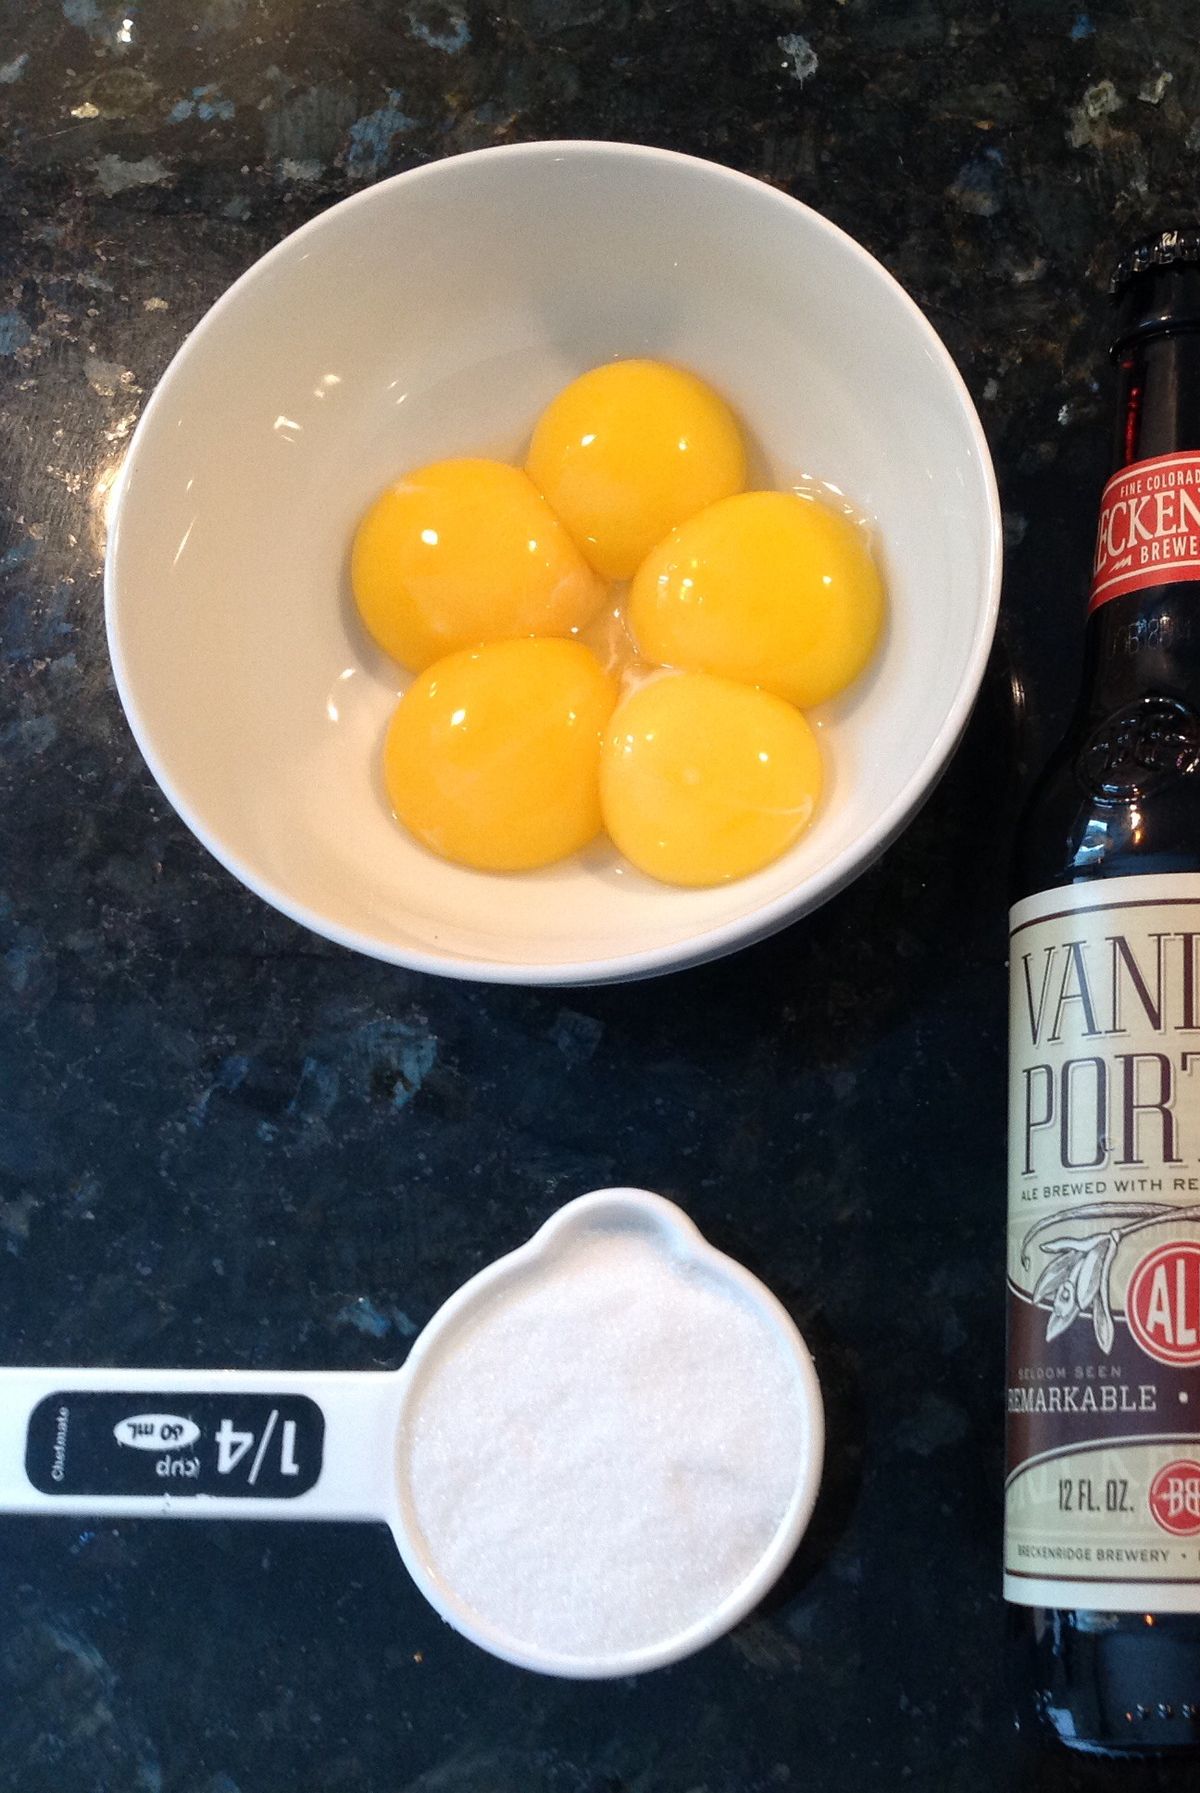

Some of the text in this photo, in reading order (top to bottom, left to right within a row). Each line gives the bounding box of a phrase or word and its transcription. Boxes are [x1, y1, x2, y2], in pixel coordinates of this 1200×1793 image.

[1120, 481, 1142, 497] FINE
[1021, 1190, 1038, 1201] ALE
[1043, 1181, 1107, 1198] BREWED
[1115, 1179, 1162, 1193] WITH
[1018, 1365, 1121, 1380] SELDOM SEEN
[214, 1409, 300, 1485] 1/4
[156, 1455, 198, 1478] cup
[1059, 1479, 1073, 1511] 12
[1078, 1479, 1101, 1512] FL.
[1106, 1479, 1135, 1512] OZ.
[1097, 1548, 1169, 1562] BREWERY
